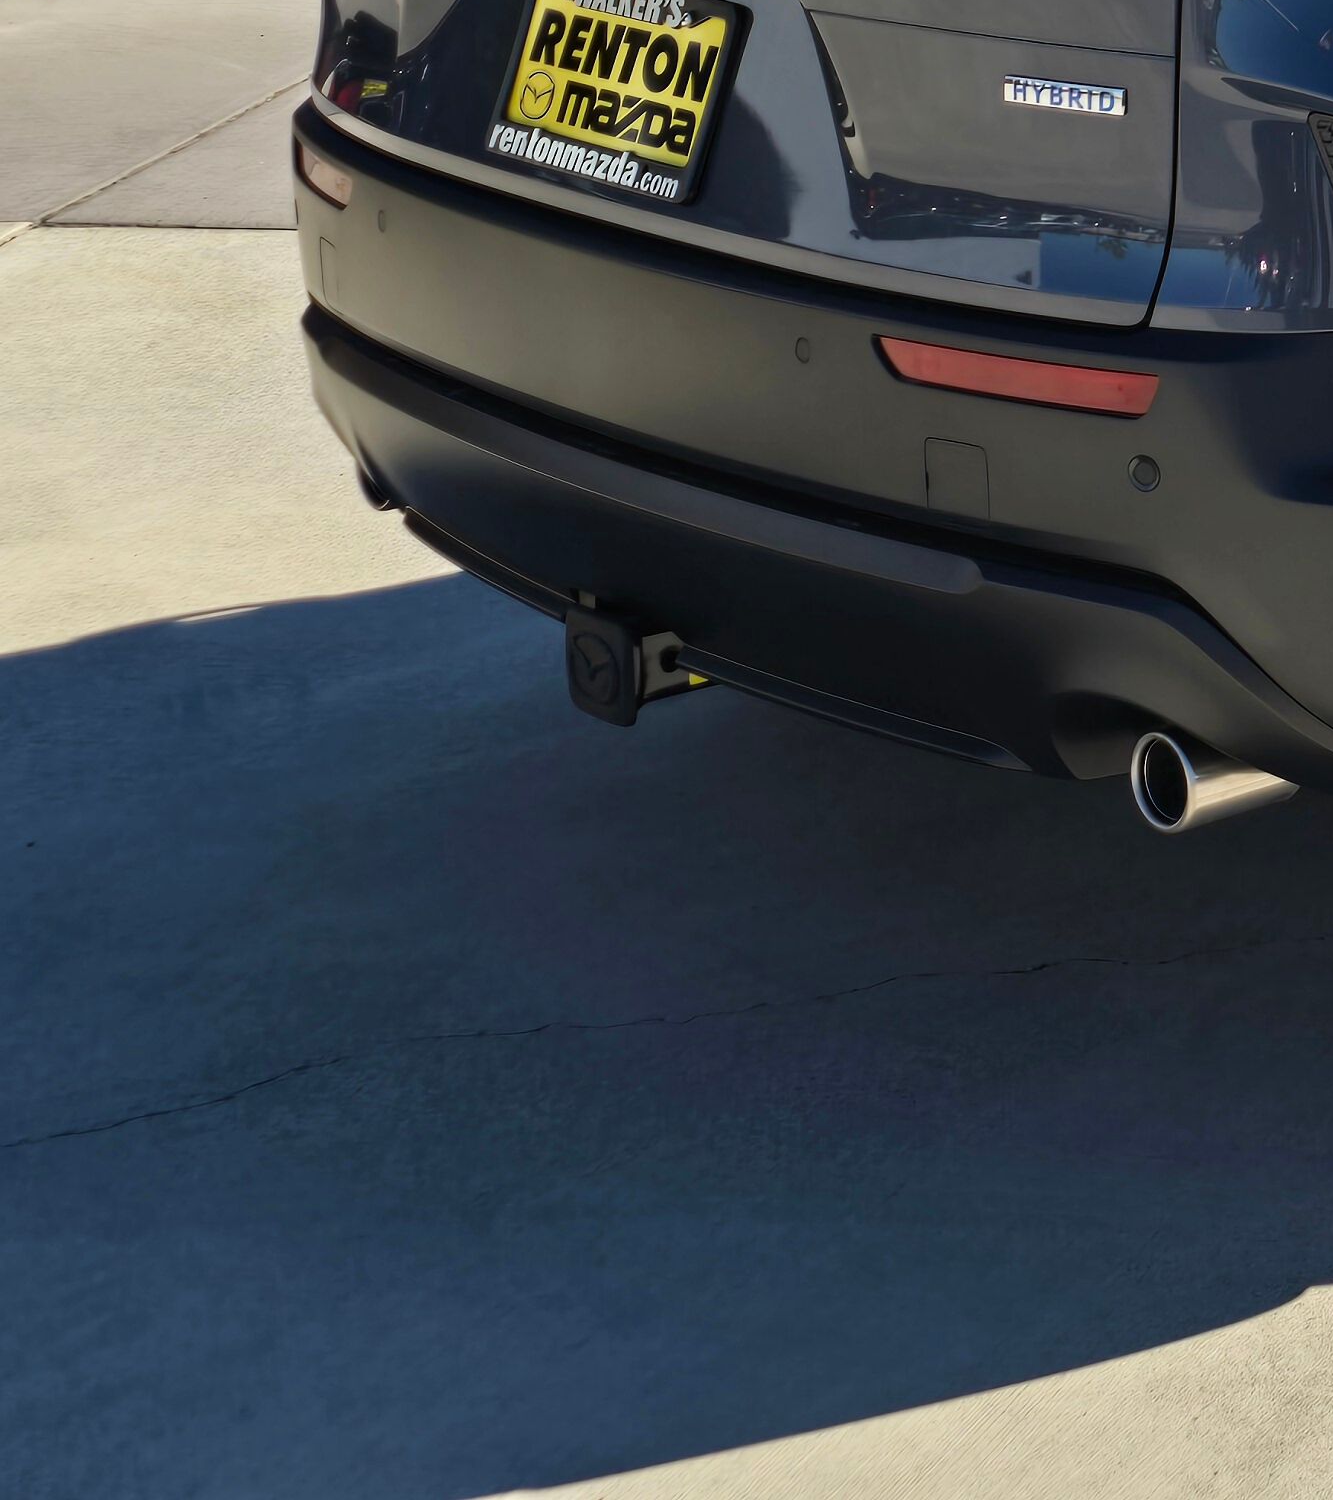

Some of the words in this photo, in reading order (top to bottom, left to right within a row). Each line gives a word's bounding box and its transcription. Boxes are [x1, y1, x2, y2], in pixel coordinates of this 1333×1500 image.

[529, 8, 719, 102] RENTON
[1012, 79, 1116, 112] HYBRID
[488, 123, 680, 199] rentonmazda.com
